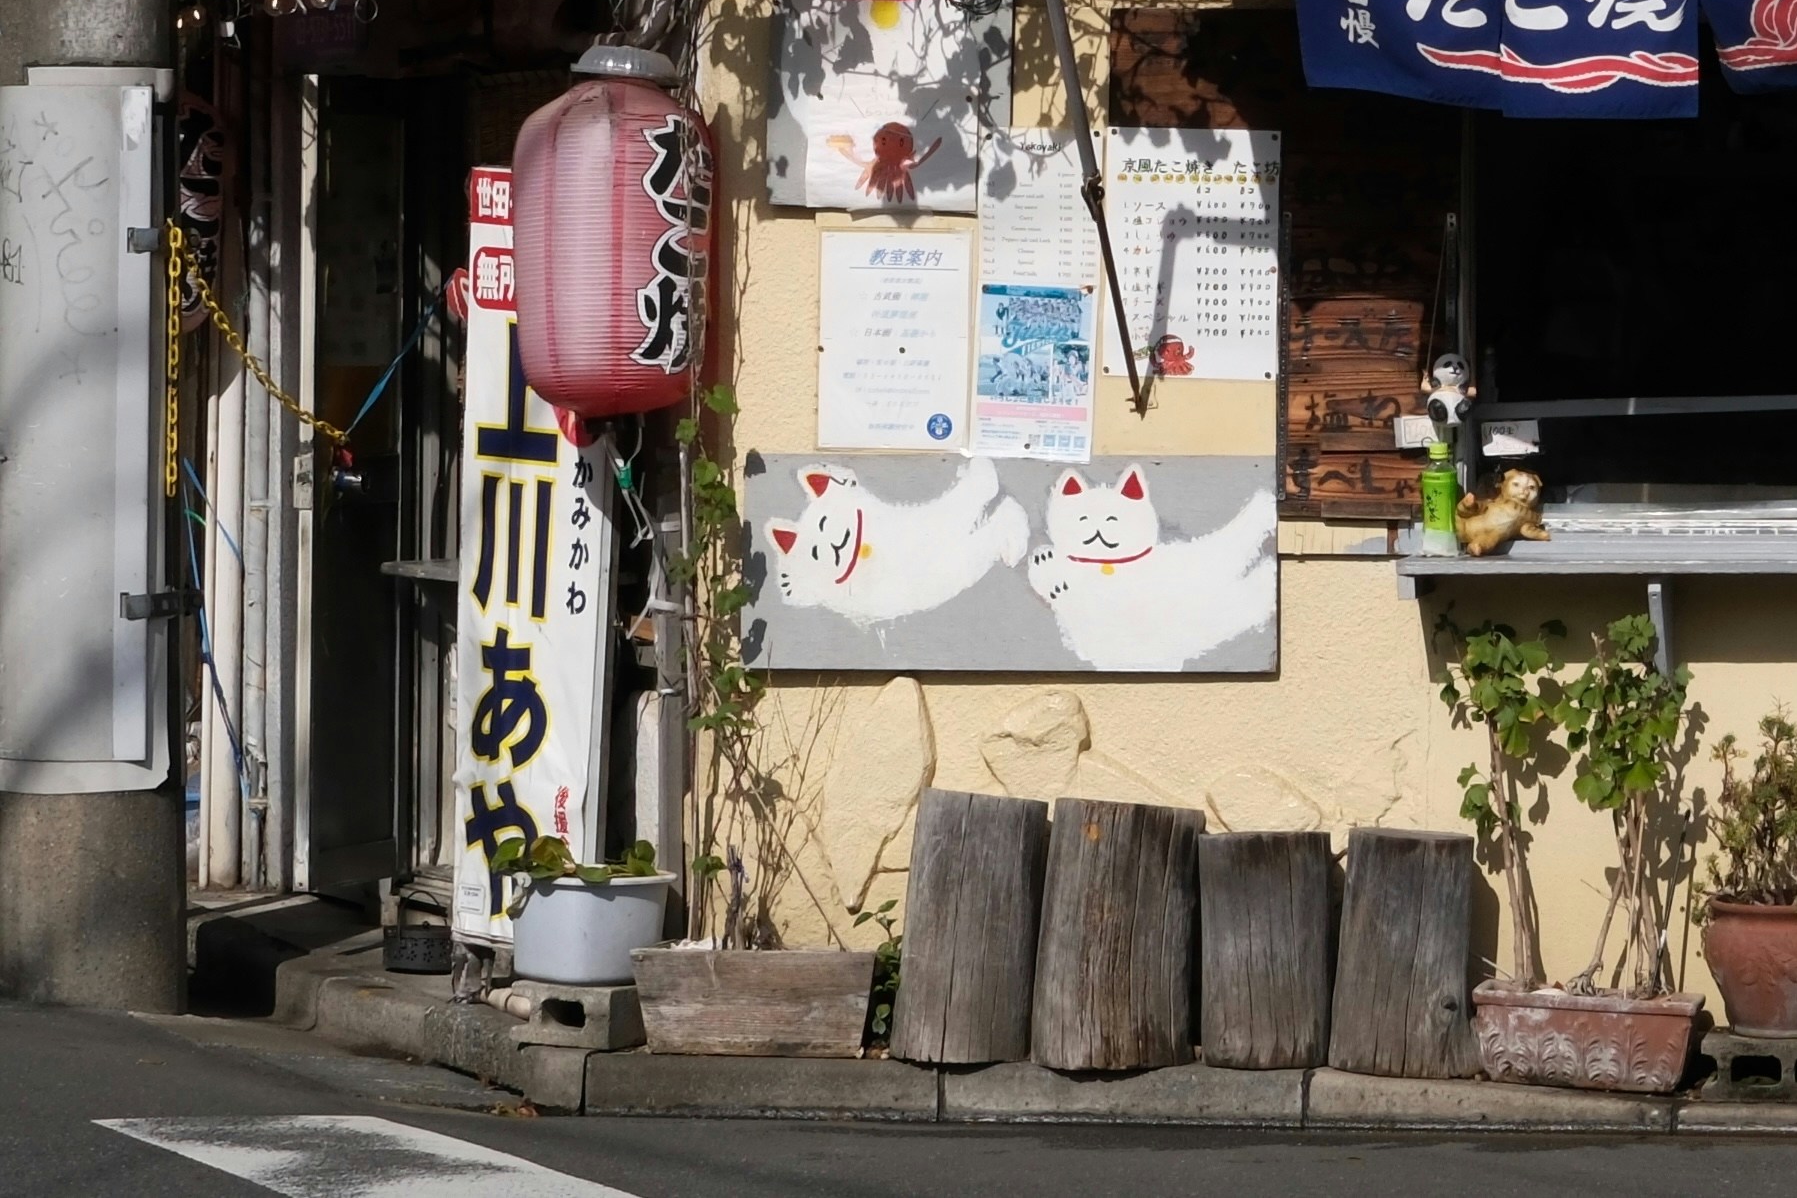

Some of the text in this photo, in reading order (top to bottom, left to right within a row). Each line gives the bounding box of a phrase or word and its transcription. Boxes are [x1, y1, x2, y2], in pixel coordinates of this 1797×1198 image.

[1122, 158, 1279, 175] 京風たこ焼き たこ坊
[477, 176, 513, 219] 世田
[1134, 201, 1166, 210] ソース
[868, 248, 944, 267] 教室案内
[1196, 313, 1227, 323] ¥900
[1196, 328, 1228, 338] ¥700
[566, 455, 593, 616] かみかわ
